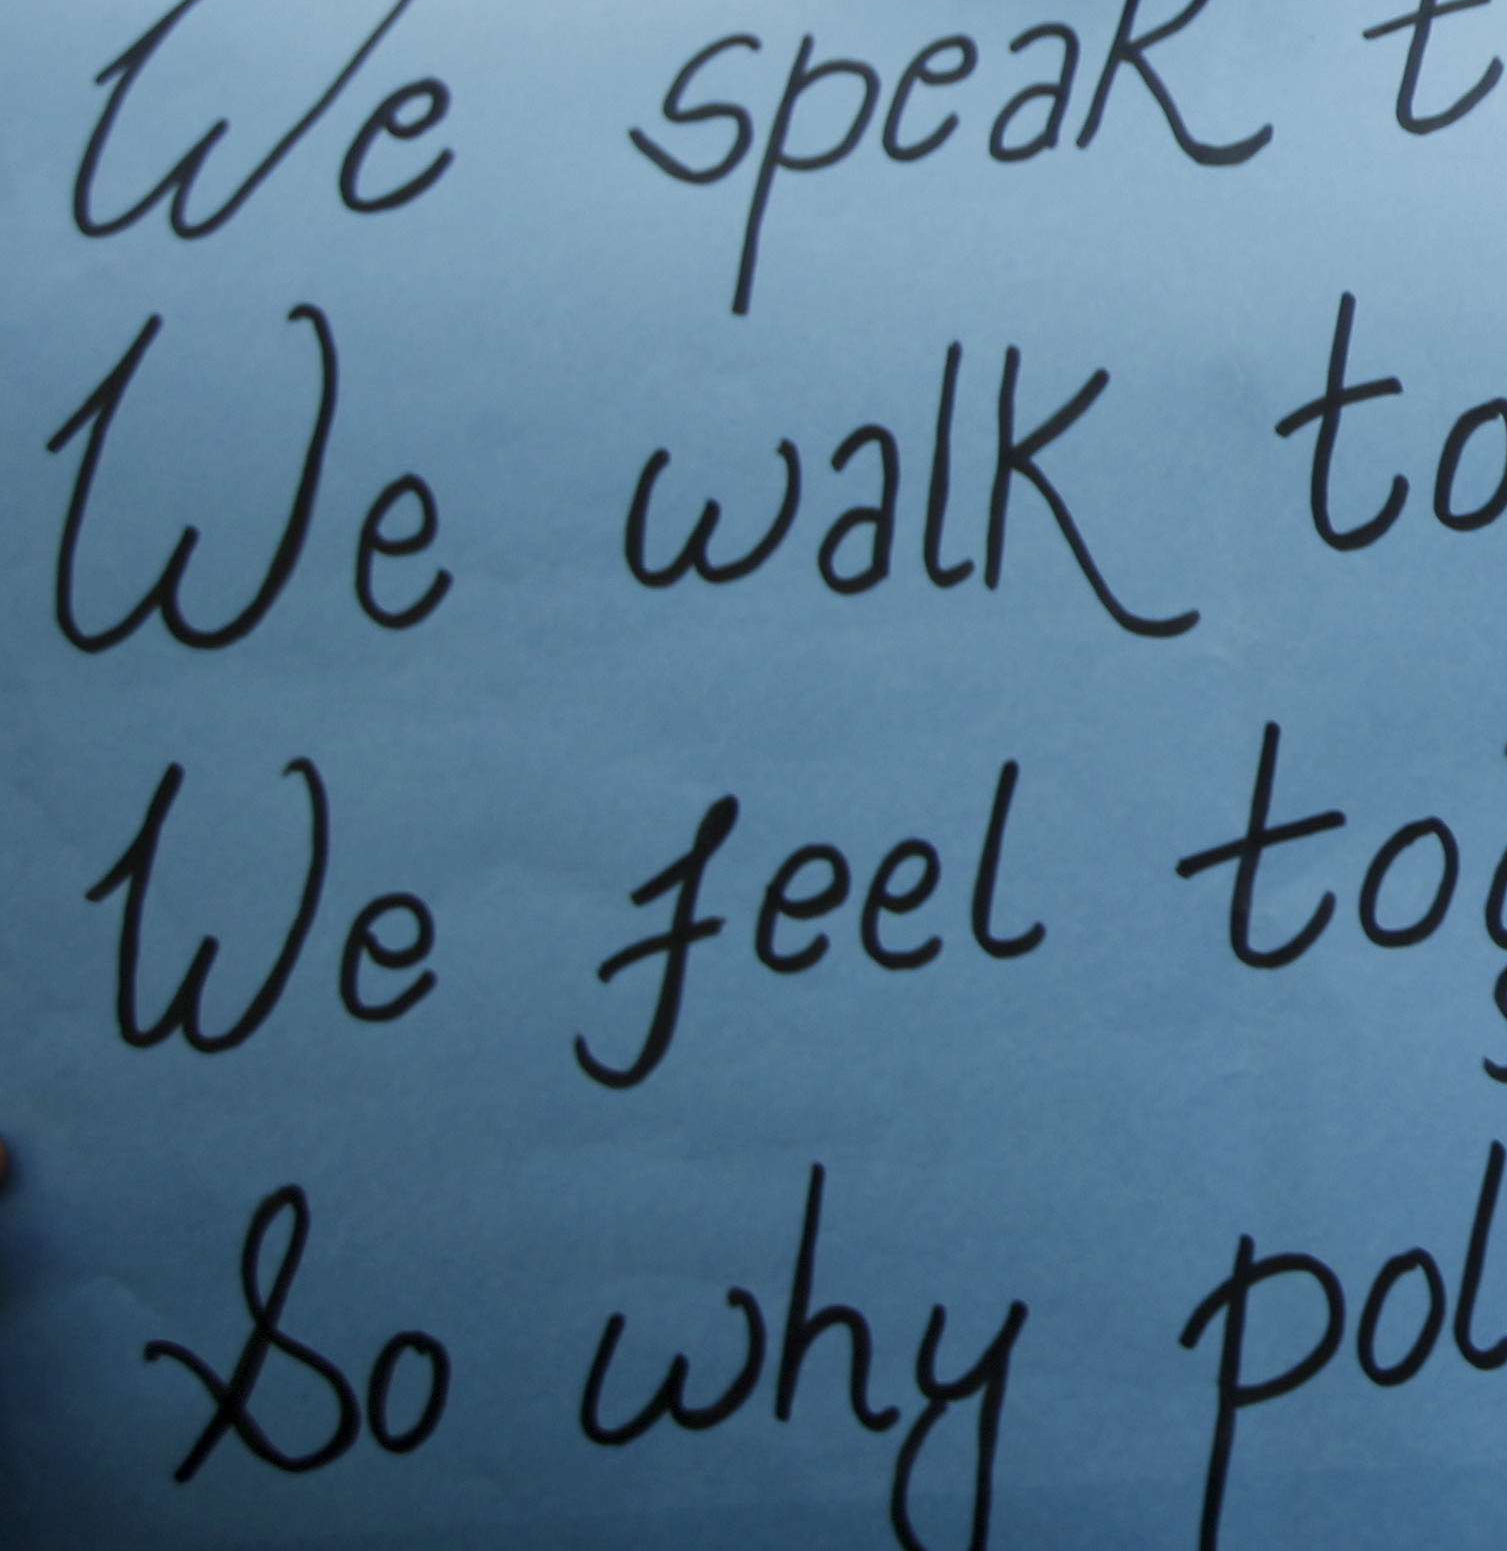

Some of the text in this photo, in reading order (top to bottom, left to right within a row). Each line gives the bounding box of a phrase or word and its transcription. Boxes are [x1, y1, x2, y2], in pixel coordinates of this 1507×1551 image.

[45, 302, 454, 656] We
[622, 340, 1201, 639] walk
[84, 756, 437, 1056] We
[573, 759, 1047, 1091] feel
[143, 1183, 451, 1485] So
[578, 1161, 1029, 1551] why
